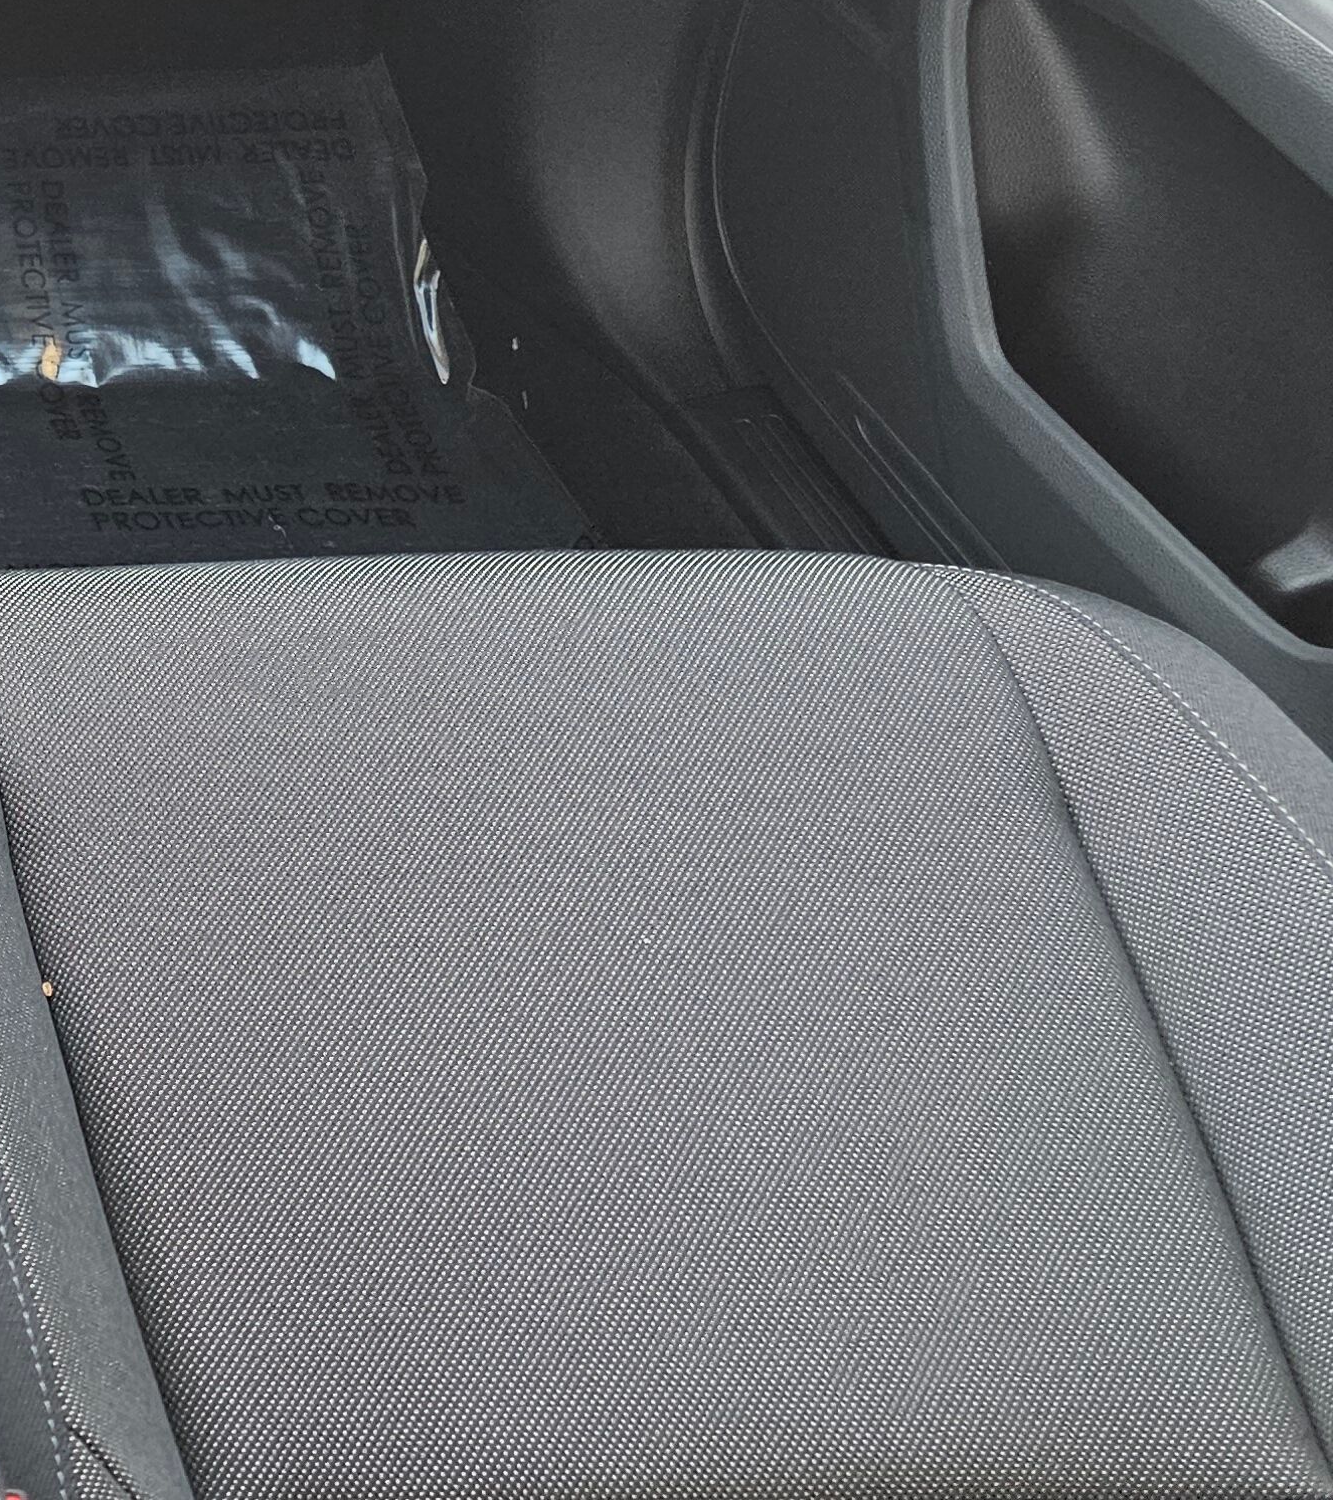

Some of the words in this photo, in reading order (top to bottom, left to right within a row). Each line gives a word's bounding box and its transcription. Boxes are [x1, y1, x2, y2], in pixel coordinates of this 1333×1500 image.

[8, 181, 54, 345] PROTECTIVE
[41, 181, 80, 282] DEALER
[80, 486, 206, 507] DEALER
[221, 483, 302, 502] MUST
[323, 482, 465, 505] REMOVE
[89, 508, 284, 531] PROTECTIVE
[297, 506, 417, 528] COVER
